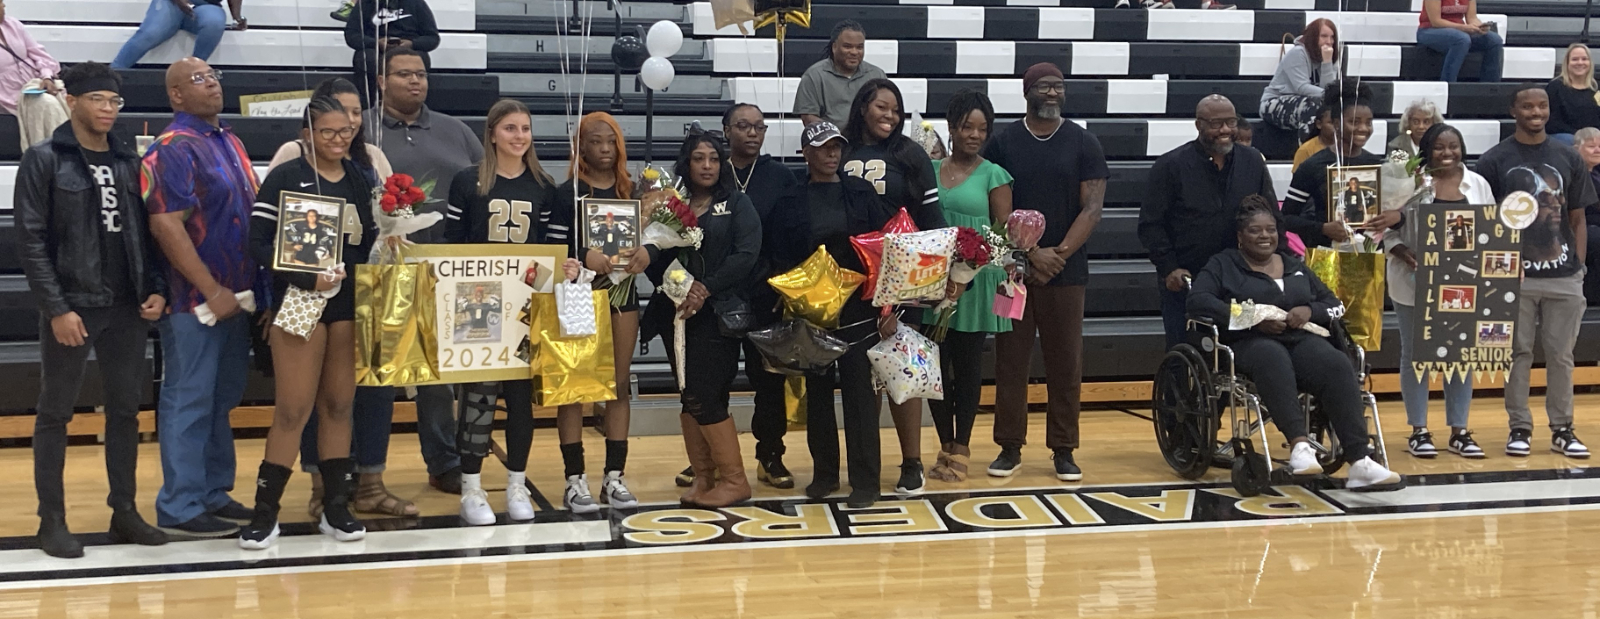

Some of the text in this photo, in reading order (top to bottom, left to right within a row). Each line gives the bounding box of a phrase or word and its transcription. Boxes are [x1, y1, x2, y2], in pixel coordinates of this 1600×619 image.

[536, 40, 544, 52] H
[548, 80, 556, 91] G
[713, 201, 728, 214] W
[1500, 197, 1535, 225] 2
[488, 199, 533, 244] 25
[303, 232, 317, 245] 34
[438, 258, 520, 278] CHERISH
[914, 261, 944, 281] LET'S
[1423, 213, 1440, 341] CAMILLE
[443, 293, 452, 340] CLASS
[504, 302, 513, 322] OF
[442, 346, 510, 368] 2024
[640, 341, 650, 356] B
[1460, 346, 1514, 362] SENIOR
[1414, 361, 1514, 373] CAPTAIN
[621, 485, 1346, 545] RAIDERS
